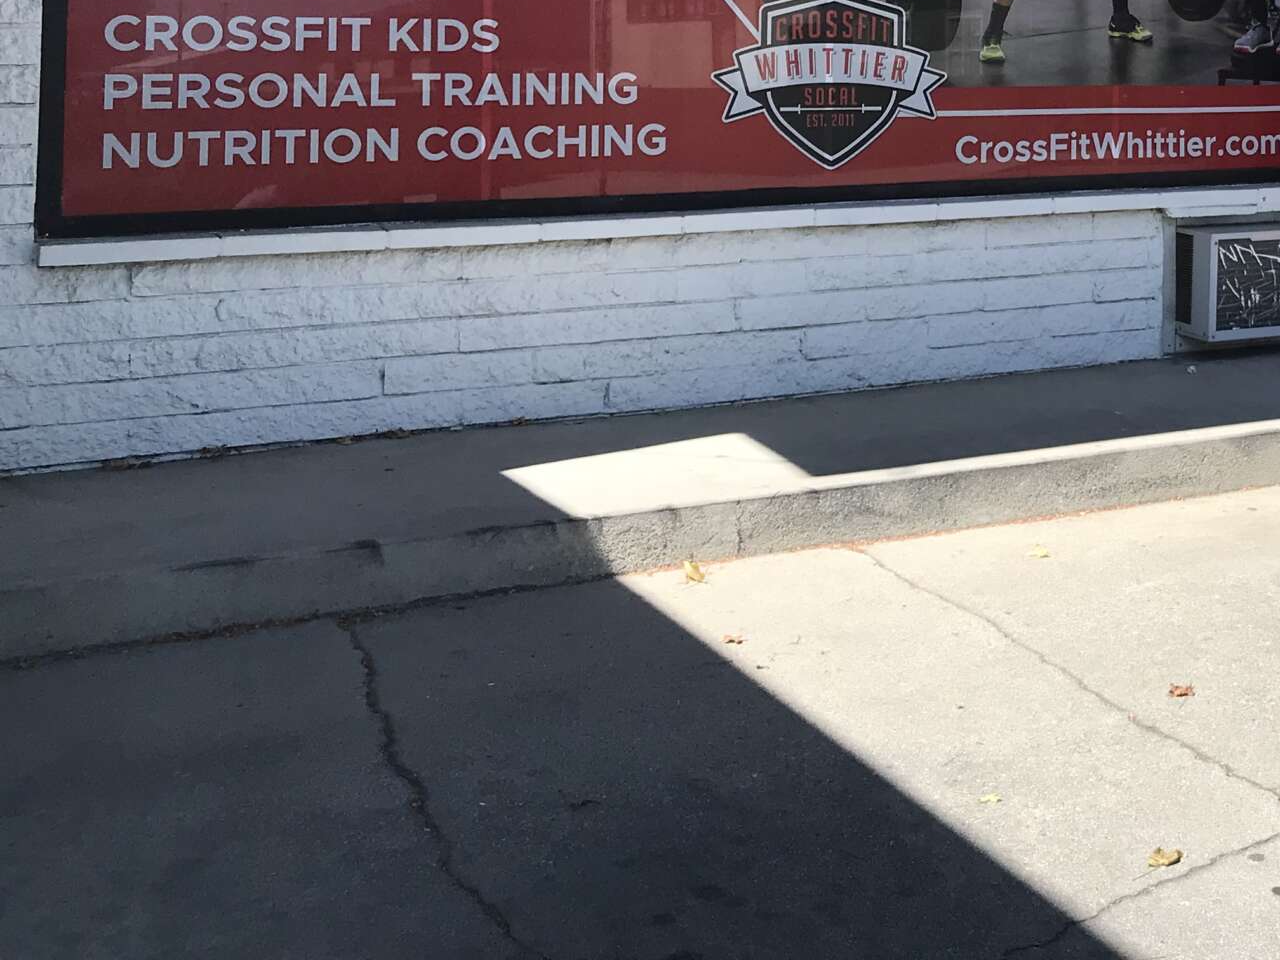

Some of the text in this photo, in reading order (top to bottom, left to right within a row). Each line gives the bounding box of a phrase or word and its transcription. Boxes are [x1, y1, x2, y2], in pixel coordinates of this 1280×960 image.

[104, 14, 500, 53] CROSSFIT KIDS
[775, 10, 891, 43] CROSSFIT
[755, 48, 909, 83] WHITTIER
[103, 71, 639, 110] PERSONAL TRAINING
[804, 88, 858, 106] SOCAL
[806, 113, 856, 128] EST. 2011
[102, 123, 667, 170] NUTRITION COACHING
